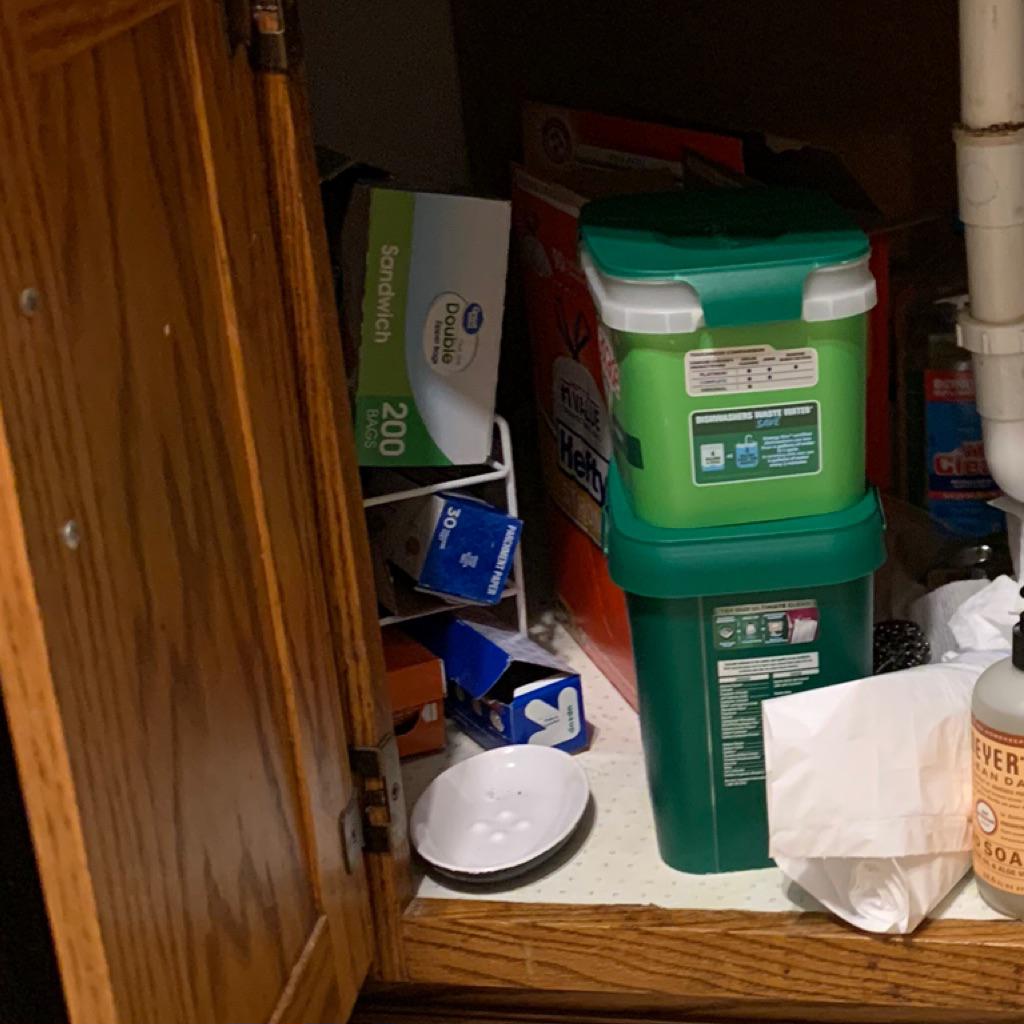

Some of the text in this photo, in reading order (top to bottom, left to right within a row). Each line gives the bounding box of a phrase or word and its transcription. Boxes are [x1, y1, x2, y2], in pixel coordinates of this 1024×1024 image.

[374, 244, 399, 343] Sandwich
[440, 303, 460, 364] Double
[364, 408, 379, 449] BAGS
[378, 402, 408, 456] 200
[444, 507, 461, 529] 30
